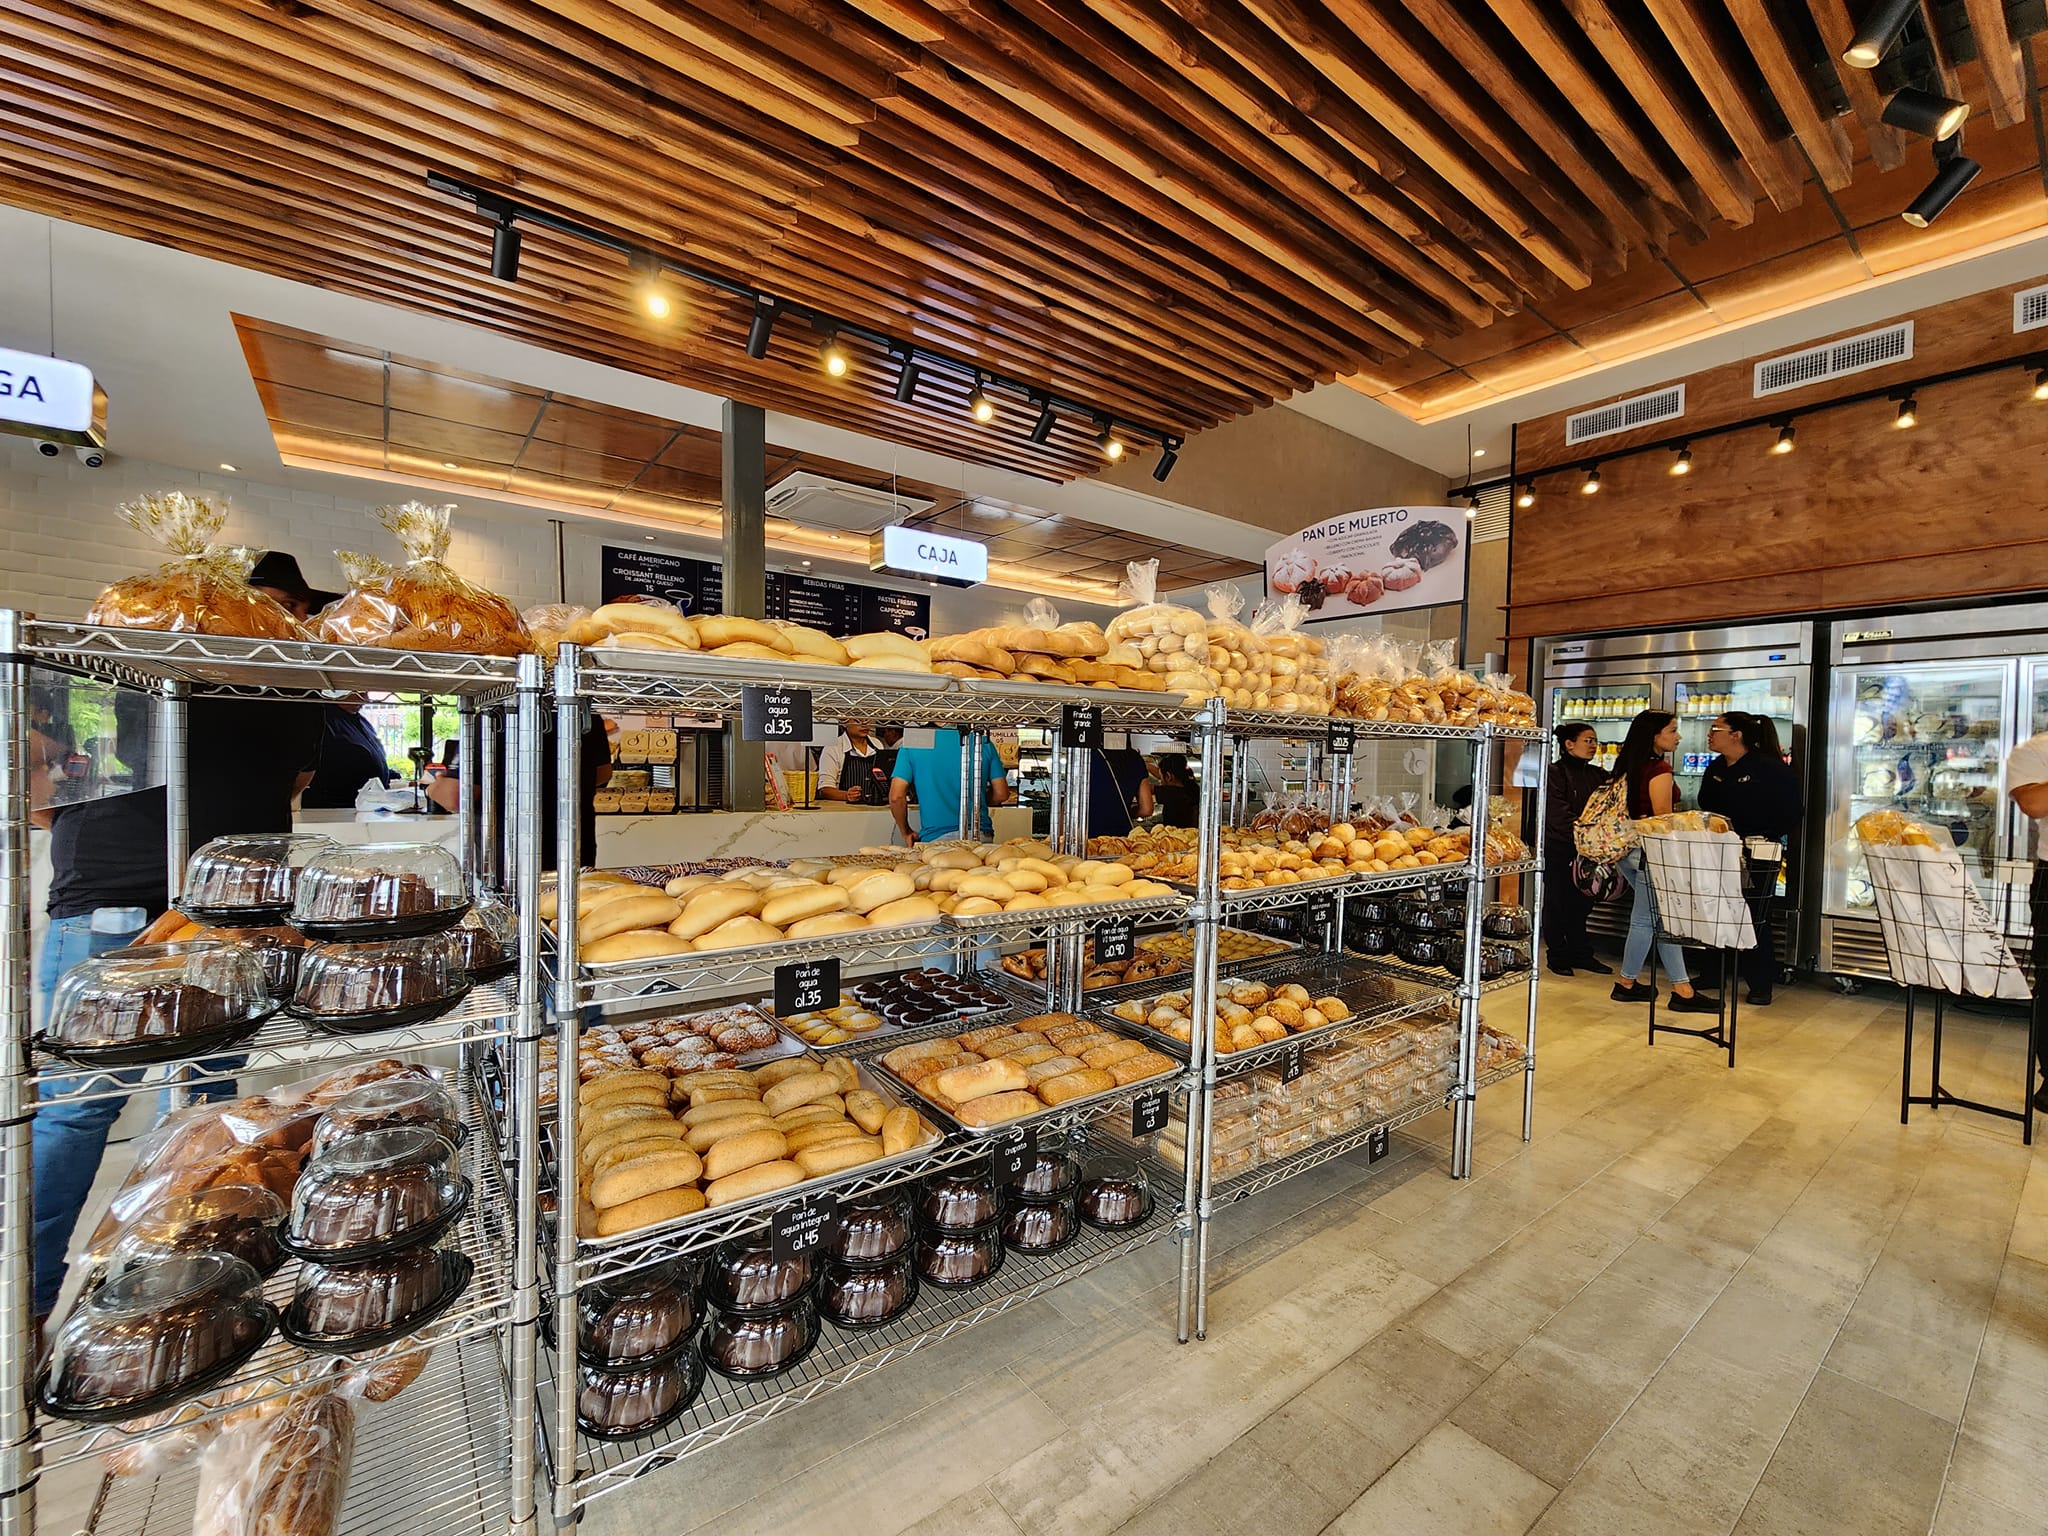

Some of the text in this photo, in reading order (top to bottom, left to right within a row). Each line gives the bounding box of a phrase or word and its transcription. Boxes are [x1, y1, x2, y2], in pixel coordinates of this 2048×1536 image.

[1302, 509, 1408, 542] PAN DE MUERTO
[618, 552, 637, 560] CAFÉ
[638, 556, 680, 567] AMERICANO
[918, 544, 958, 566] CAJA
[613, 568, 685, 583] CROISSANT RELLENO
[803, 579, 844, 591] BEBIDAS FRÍAS
[880, 606, 916, 616] CAPPUCCINO
[764, 695, 791, 704] Pan de
[768, 707, 788, 717] agua
[765, 719, 792, 735] Q1.35
[1105, 944, 1125, 958] Q0.90
[796, 968, 821, 979] Pan de
[799, 979, 818, 991] agua
[795, 990, 821, 1008] Q1.35
[1011, 1157, 1021, 1172] Q3
[792, 1208, 816, 1222] Pan de
[781, 1223, 800, 1237] agua
[793, 1228, 819, 1250] Q1.45
